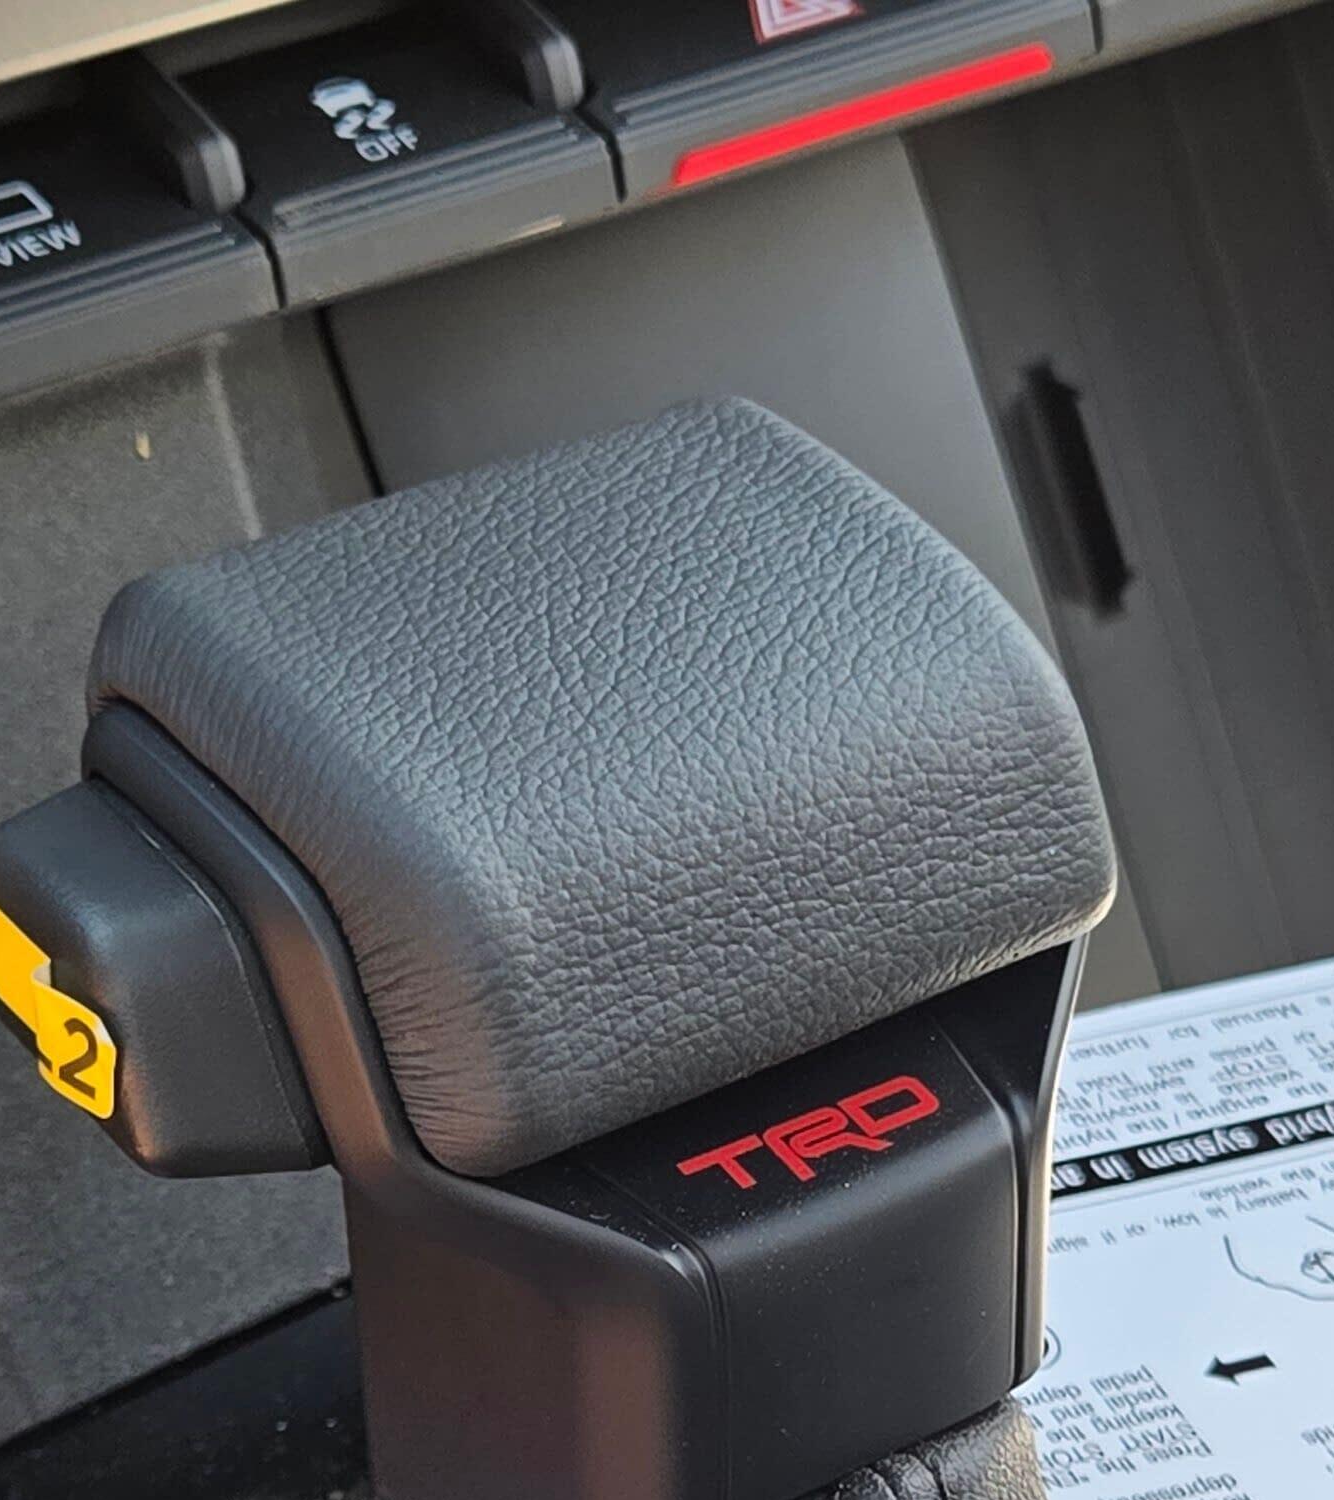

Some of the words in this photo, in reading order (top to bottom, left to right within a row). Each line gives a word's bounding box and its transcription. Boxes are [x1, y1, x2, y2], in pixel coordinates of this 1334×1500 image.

[355, 122, 418, 161] OFF
[676, 1074, 940, 1190] TRD
[1139, 1128, 1253, 1167] system
[1090, 1156, 1130, 1179] in
[1090, 1365, 1154, 1393] pedal
[1104, 1383, 1167, 1411] pedal
[1050, 1402, 1095, 1423] and
[1090, 1404, 1183, 1433] keeping
[1045, 1425, 1086, 1442] the
[1143, 1439, 1211, 1462] Press
[1096, 1457, 1136, 1473] the
